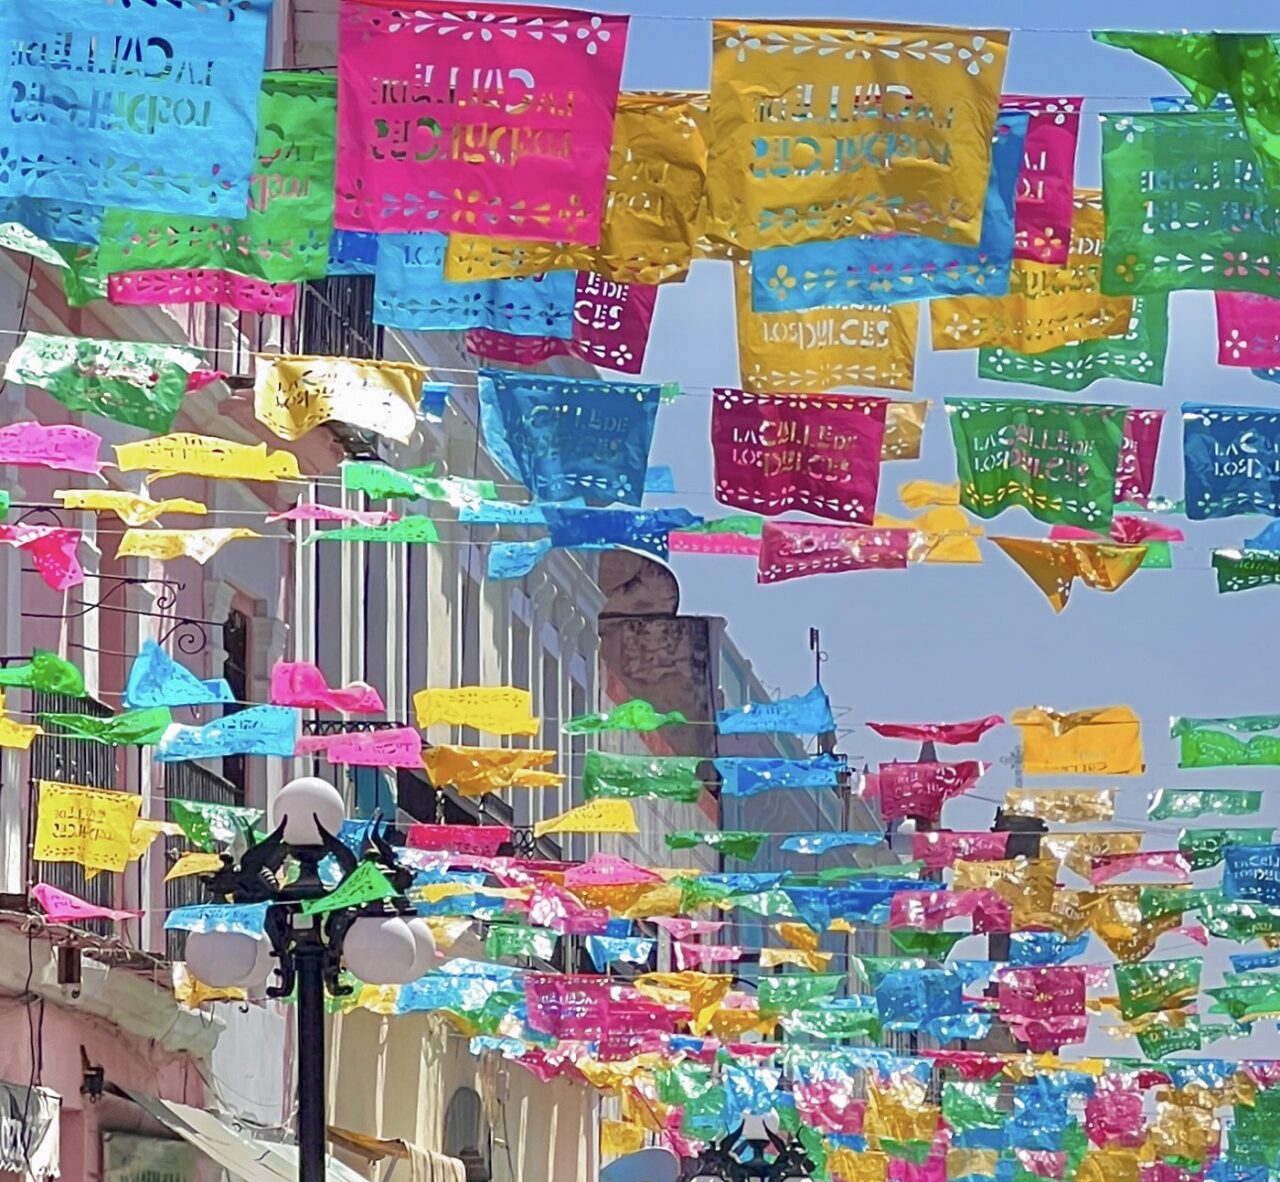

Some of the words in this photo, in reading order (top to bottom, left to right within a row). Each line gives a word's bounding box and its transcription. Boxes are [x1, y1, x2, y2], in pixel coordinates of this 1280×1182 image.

[762, 321, 798, 344] LOS
[798, 318, 890, 350] DULCES
[734, 427, 758, 444] LA
[759, 420, 830, 448] CALLE
[974, 434, 997, 451] LA
[1215, 443, 1239, 457] LA
[733, 448, 762, 468] LOS
[763, 449, 852, 483] DULCES
[974, 452, 1003, 472] LOS
[1214, 457, 1246, 477] LOS
